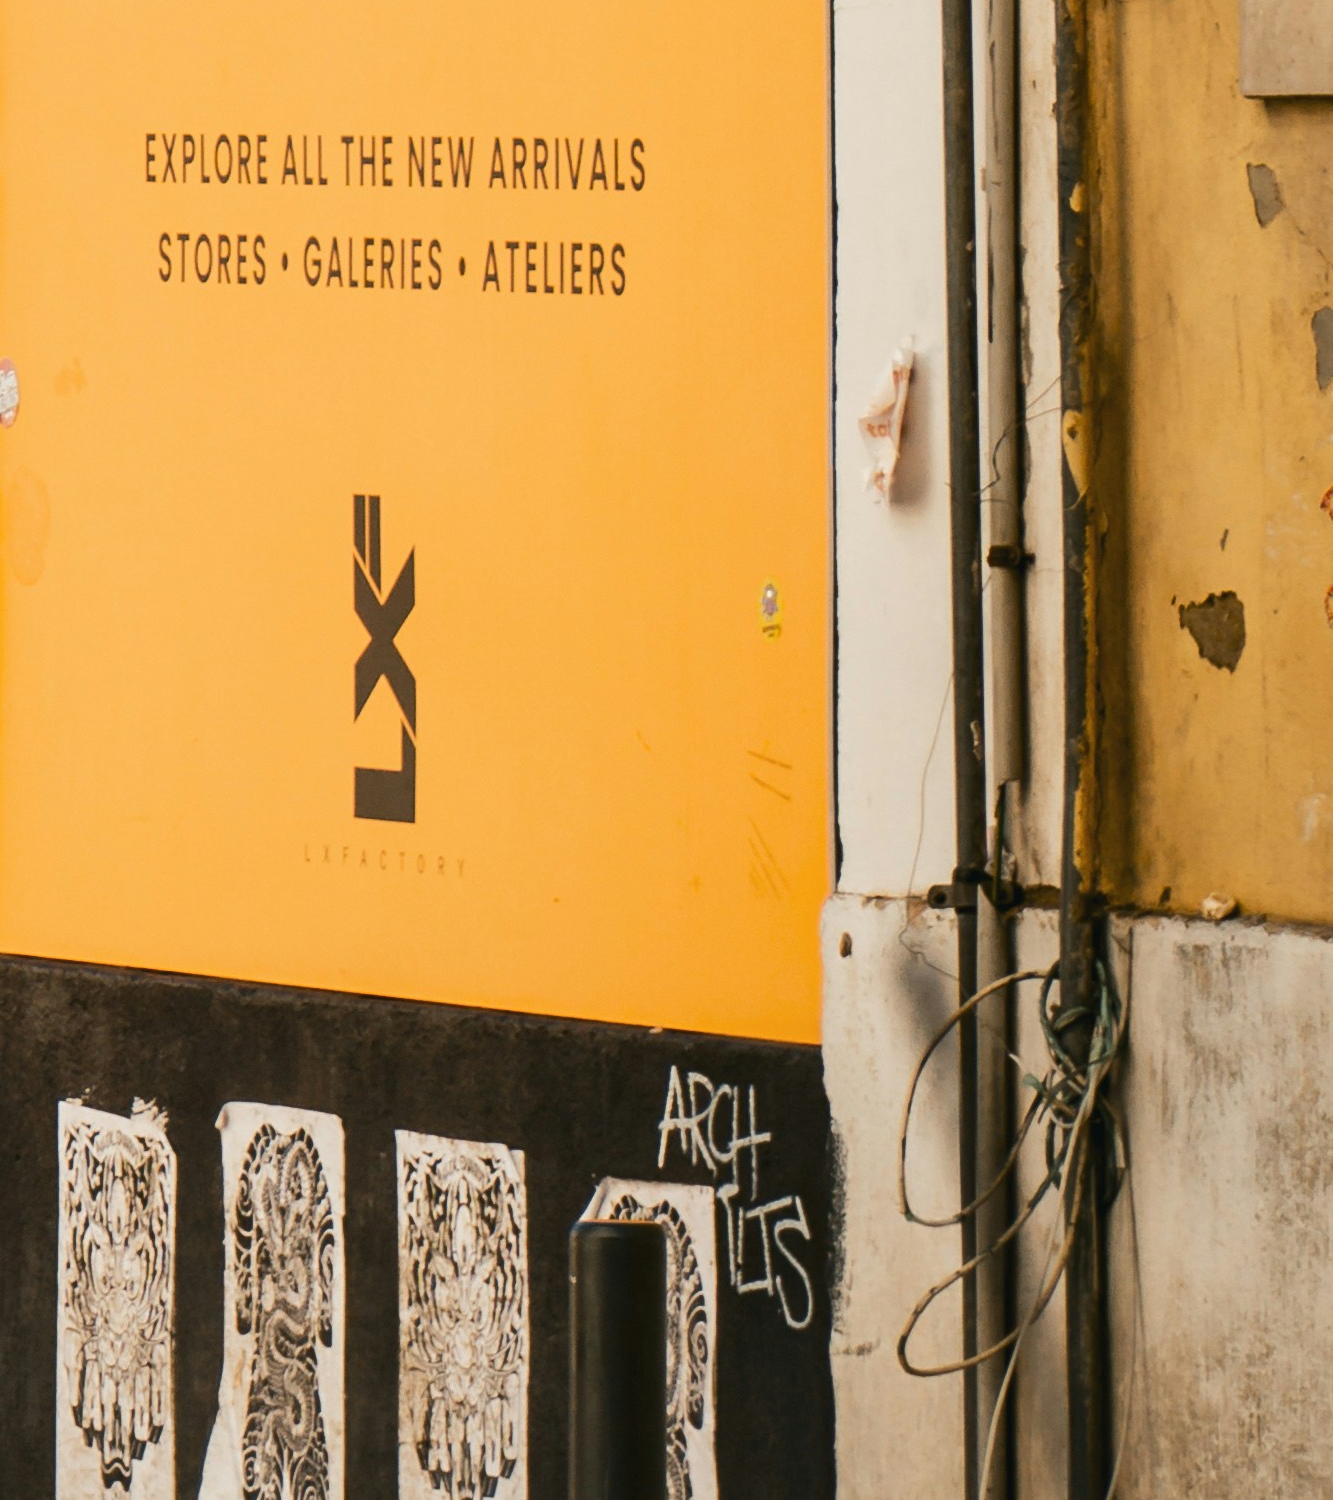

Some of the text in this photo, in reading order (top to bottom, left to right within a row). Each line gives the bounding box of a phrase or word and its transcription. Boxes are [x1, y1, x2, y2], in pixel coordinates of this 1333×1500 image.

[145, 133, 646, 192] EXPLORE ALL THE NEW ARRIVALS
[158, 232, 626, 297] STORES GALERIES ATELIERS
[656, 1064, 773, 1202] ARCH
